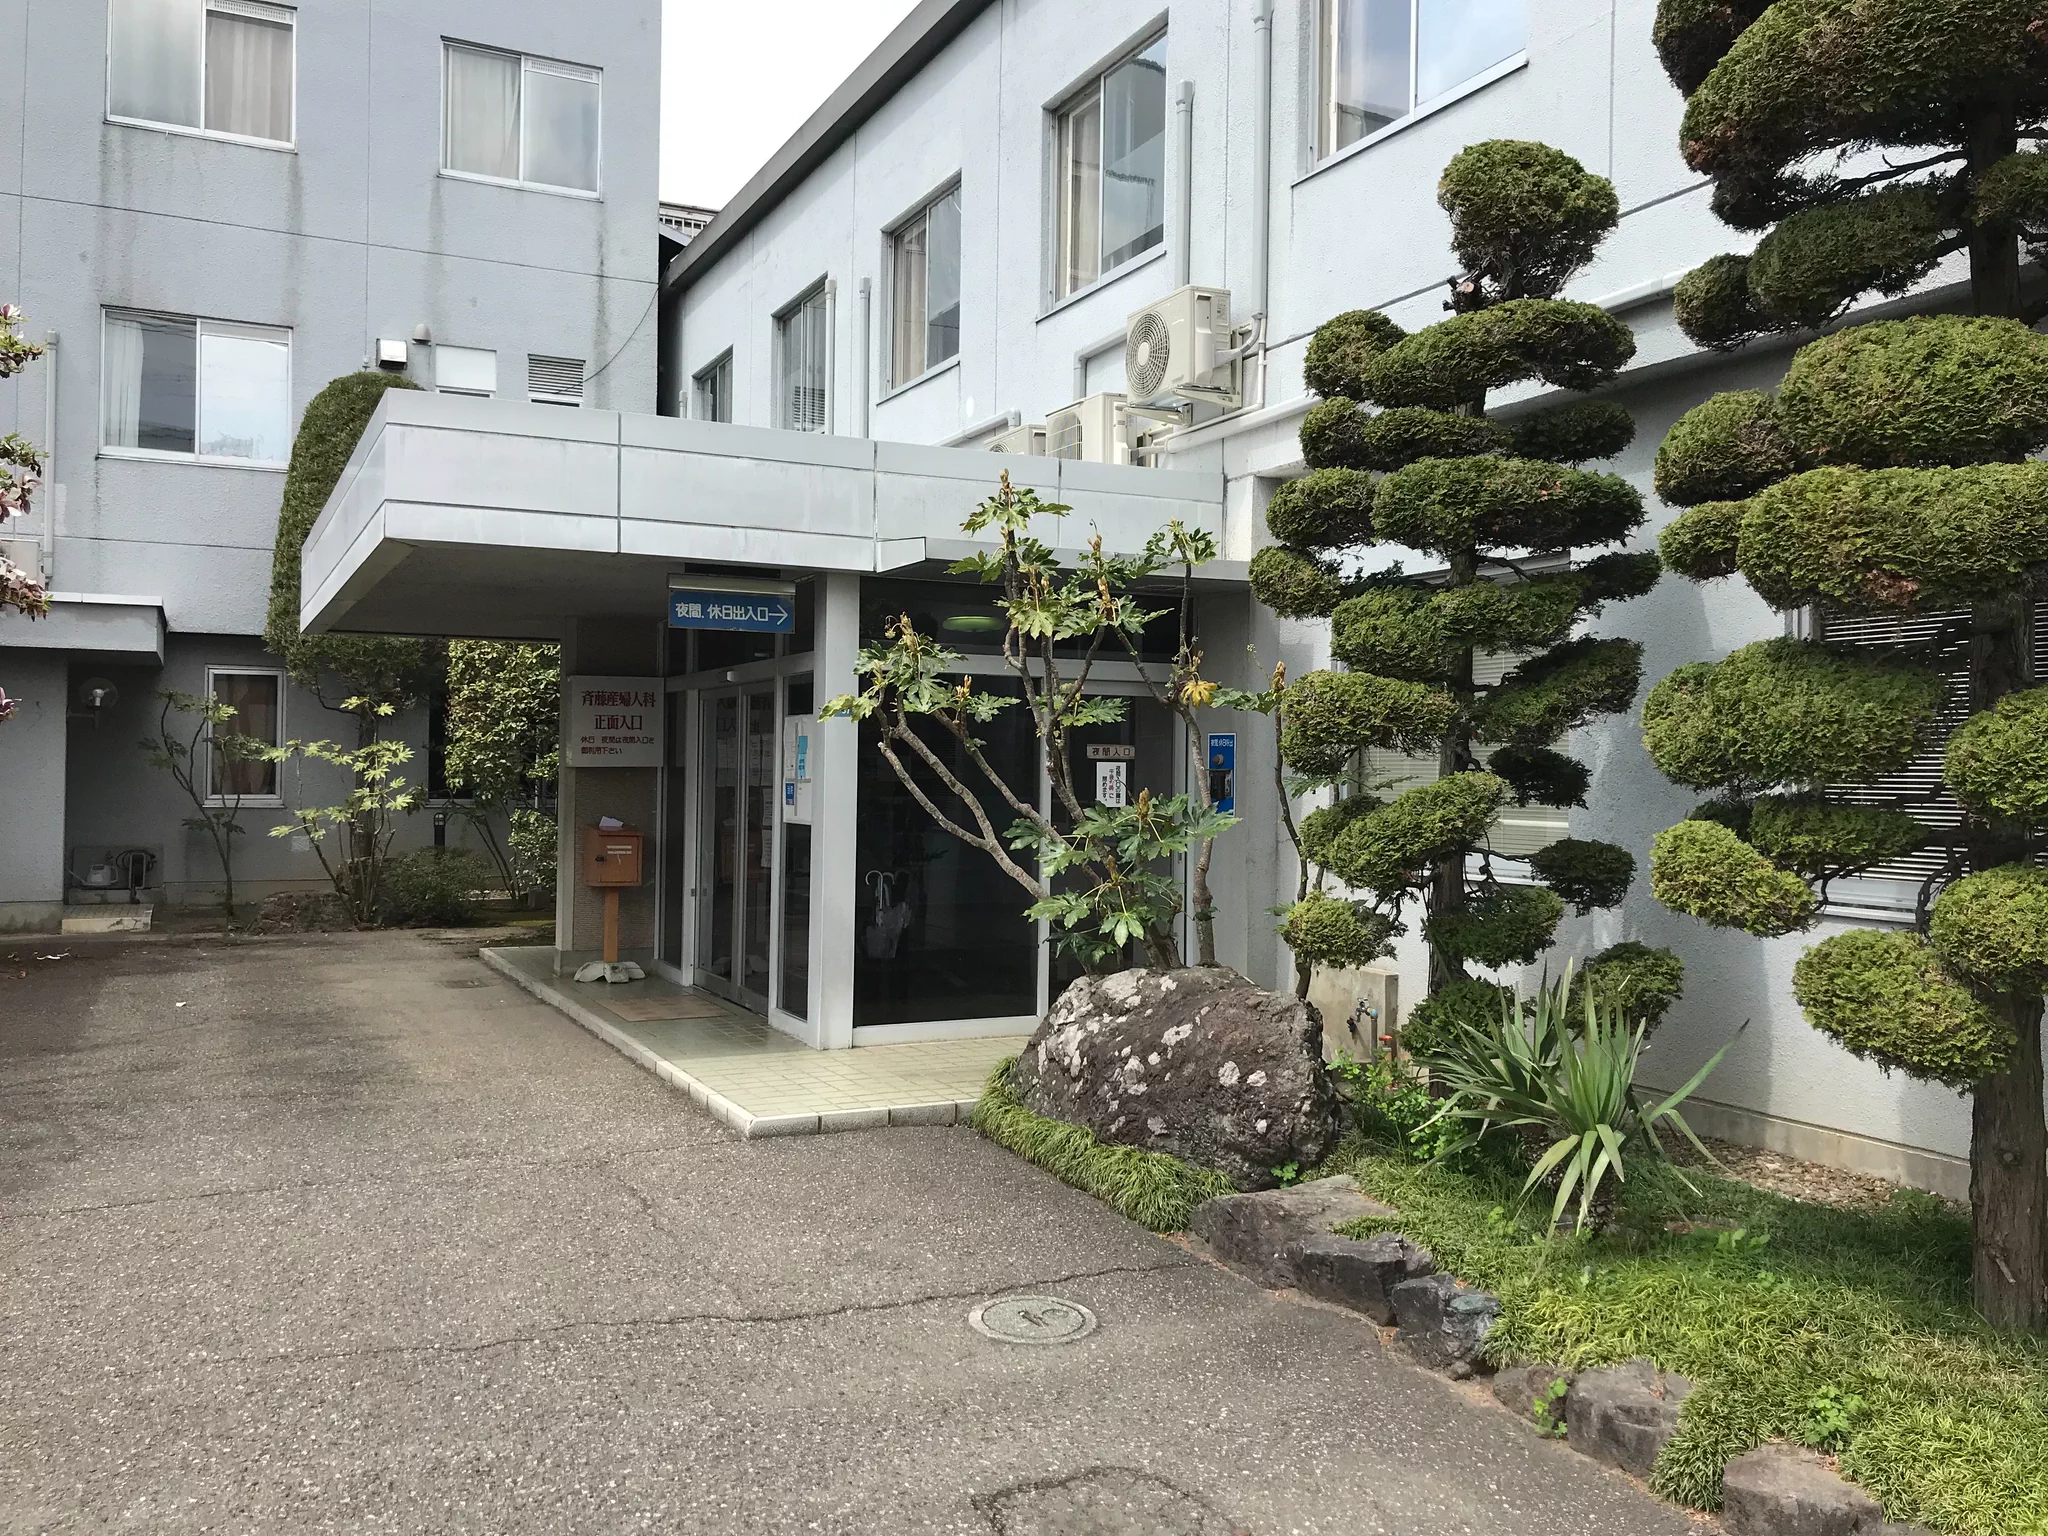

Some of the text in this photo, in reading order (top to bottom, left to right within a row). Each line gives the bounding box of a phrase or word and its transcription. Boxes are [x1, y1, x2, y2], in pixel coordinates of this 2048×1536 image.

[581, 690, 657, 707] 斉藤産婦人科
[594, 714, 643, 730] 正面入口
[581, 736, 595, 744] 休日
[581, 746, 622, 754] 御利用下さい
[1092, 747, 1130, 756] 夜間入口
